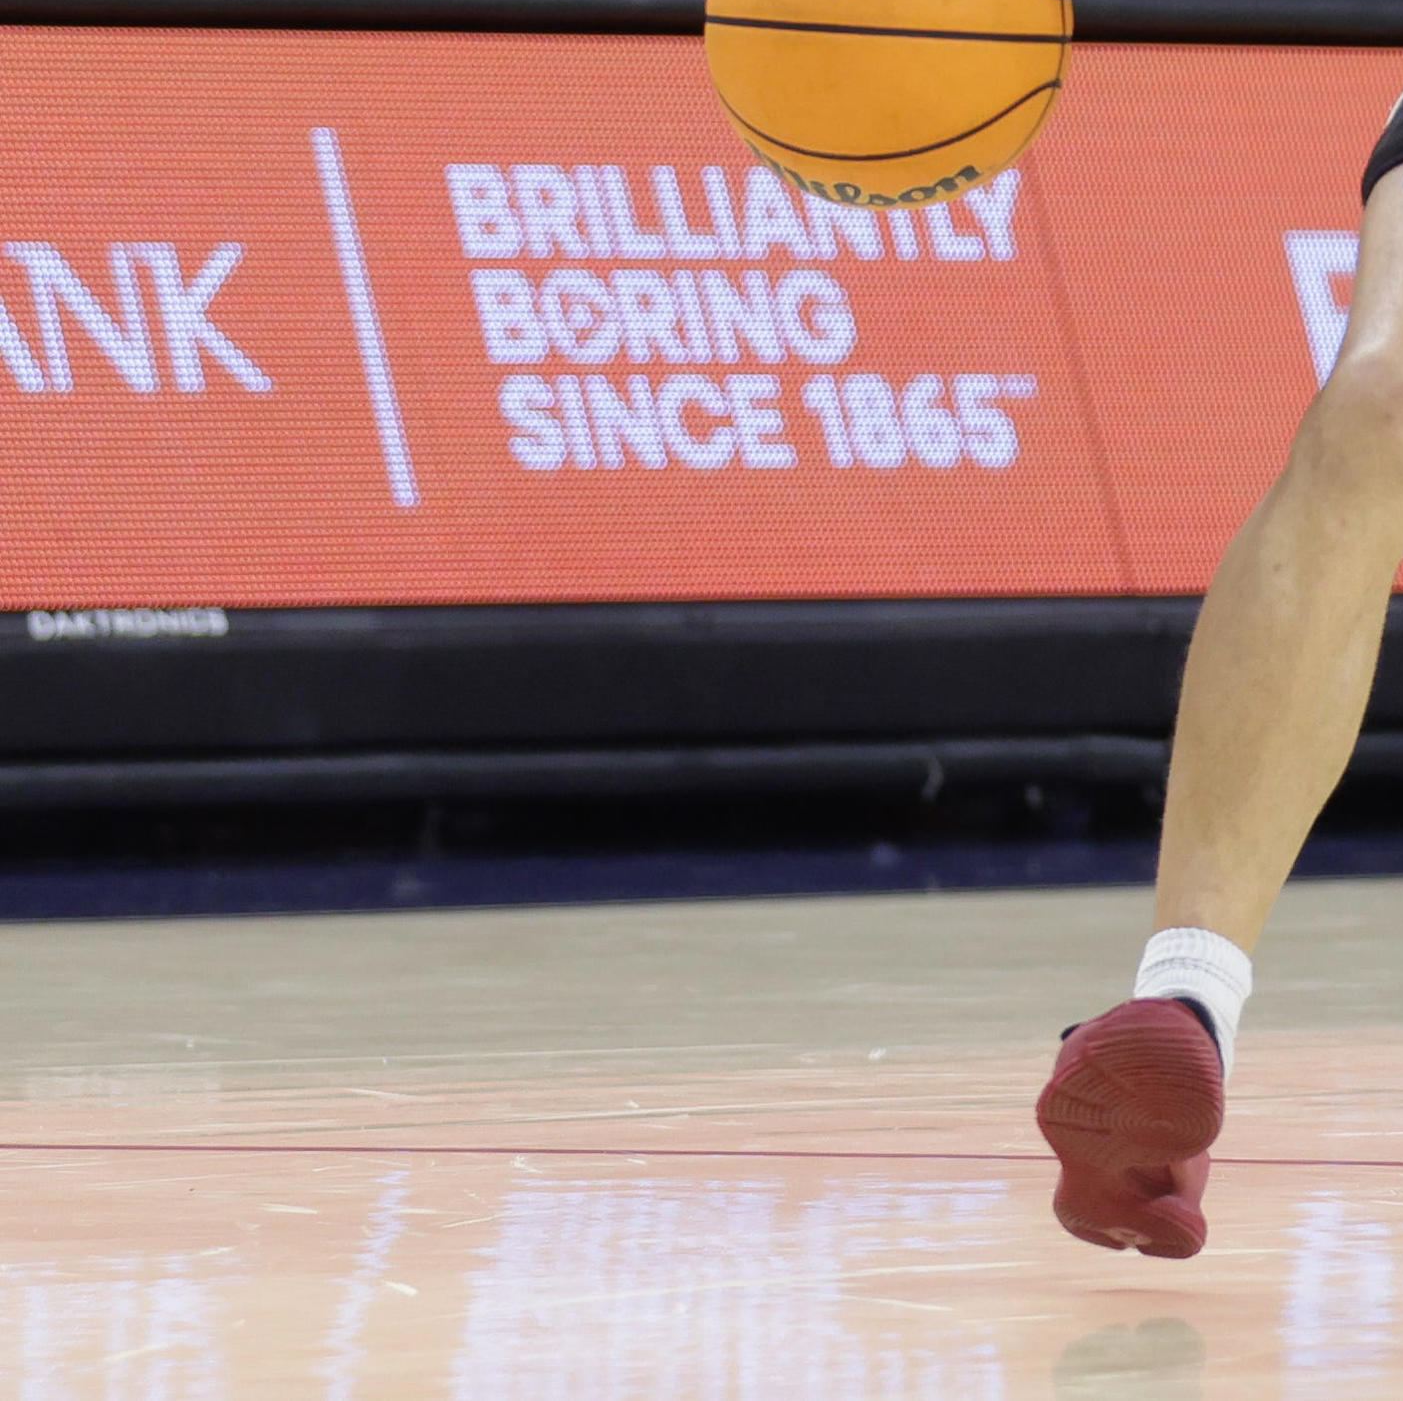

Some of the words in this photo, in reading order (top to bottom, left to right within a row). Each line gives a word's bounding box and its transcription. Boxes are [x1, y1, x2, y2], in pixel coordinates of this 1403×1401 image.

[470, 269, 858, 365] BORING
[498, 374, 798, 471] SINCE
[802, 374, 1020, 471] 1865
